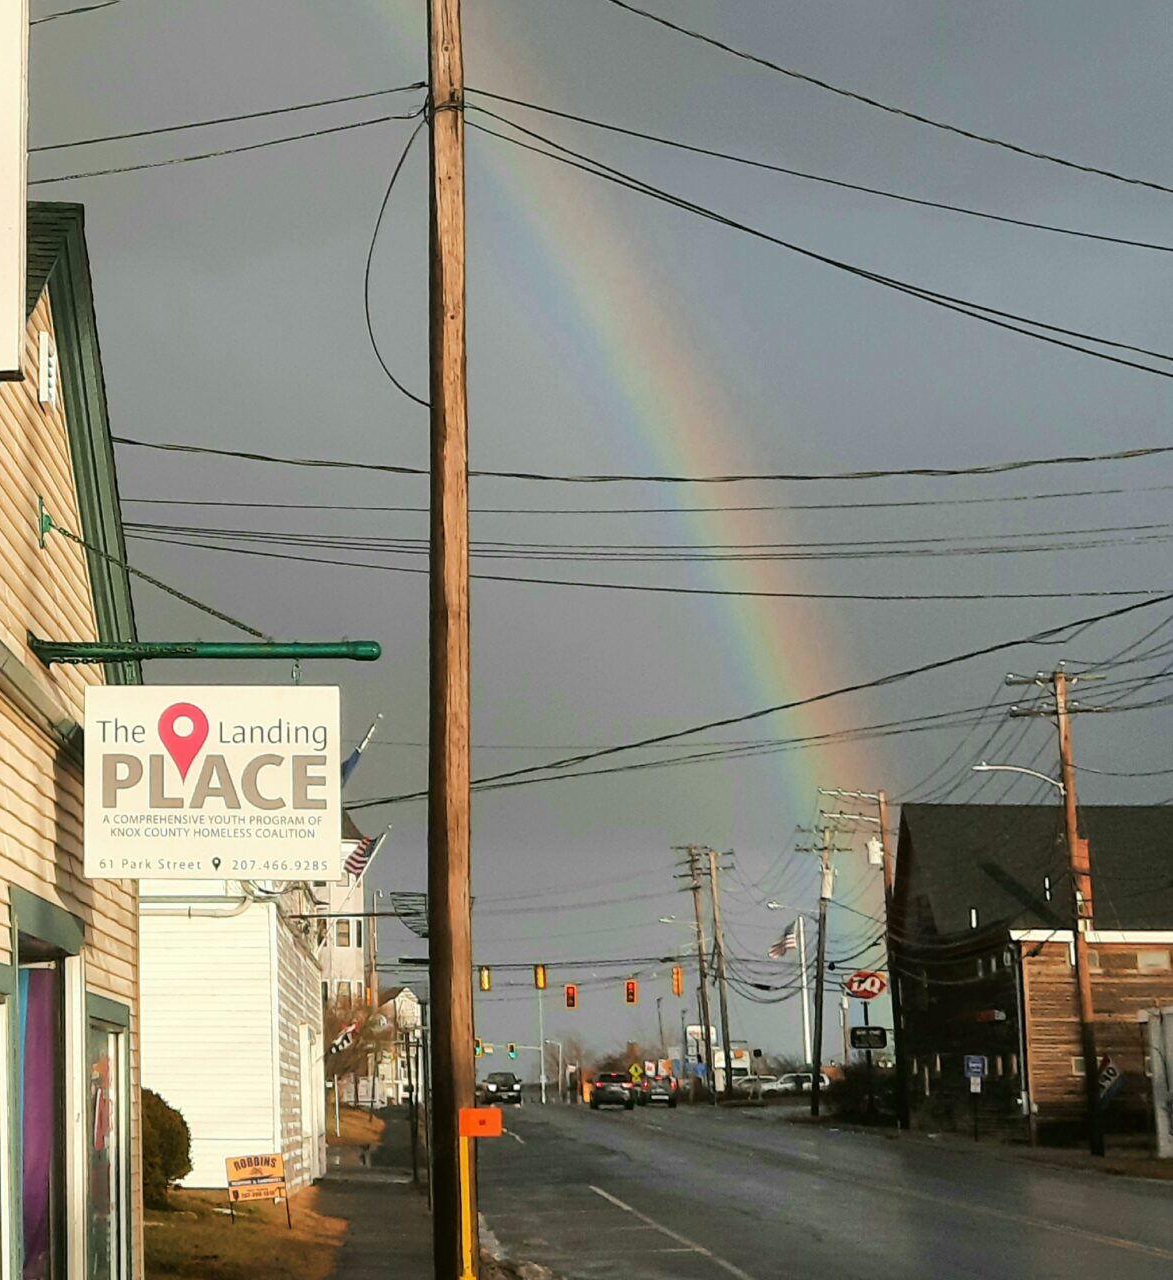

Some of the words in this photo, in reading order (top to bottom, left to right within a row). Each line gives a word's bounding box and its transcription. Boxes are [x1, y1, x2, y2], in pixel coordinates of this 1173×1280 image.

[96, 718, 146, 744] The
[218, 718, 329, 752] Landing
[102, 753, 328, 810] PLACE
[102, 815, 110, 825] A
[113, 815, 206, 825] COMPREHENSIVE
[208, 815, 246, 825] YOUTH
[249, 816, 305, 826] PROGRAM
[308, 816, 323, 826] OF
[110, 827, 141, 838] KNOX
[144, 827, 190, 838] COUNTY
[193, 828, 253, 838] HOMELESS
[255, 828, 316, 838] COALITION
[99, 859, 115, 869] 61
[122, 859, 152, 870] Park
[158, 859, 202, 870] Street
